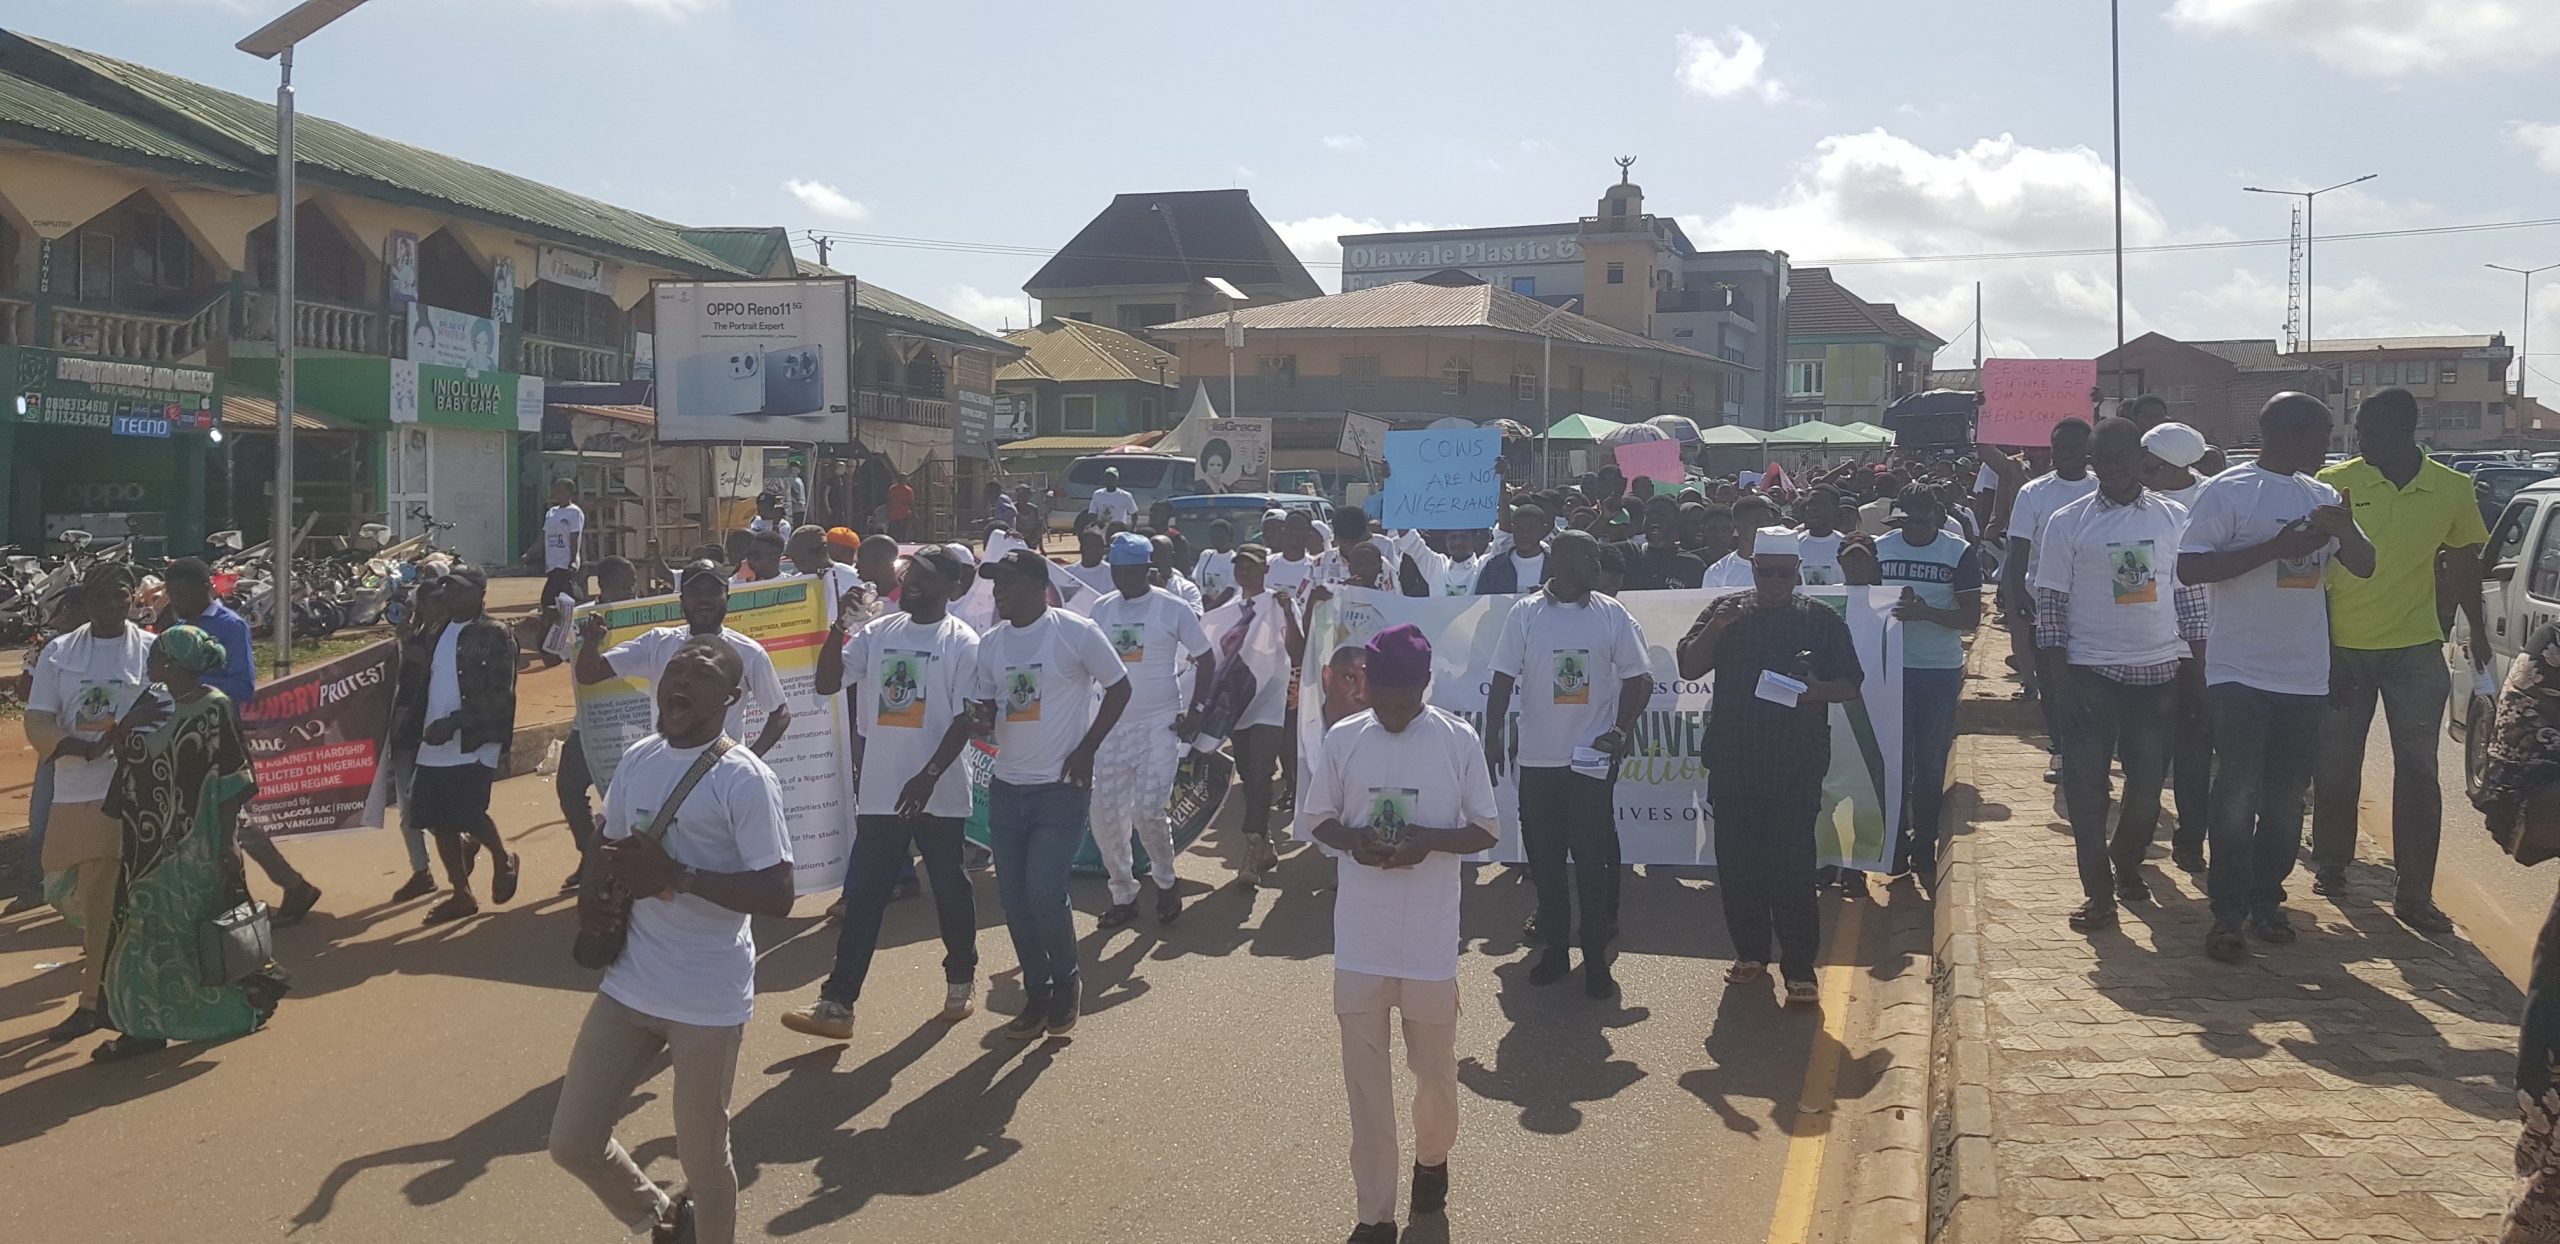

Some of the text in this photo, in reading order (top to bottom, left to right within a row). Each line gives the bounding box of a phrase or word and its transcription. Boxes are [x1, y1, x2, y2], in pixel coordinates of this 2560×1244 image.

[1350, 236, 1579, 269] Olawale Plastic &
[41, 238, 52, 293] TRAINING
[706, 302, 745, 316] OPPO
[747, 302, 791, 316] Reno11
[713, 321, 785, 332] The Portrait Expert
[2057, 362, 2091, 375] THE
[432, 378, 501, 400] INIOLUWA
[436, 396, 499, 415] BABY CARE
[119, 417, 168, 434] TECNO
[1418, 438, 1483, 463] COWS
[1425, 473, 1463, 492] ARE
[1881, 562, 1939, 580] MKO GCFR
[240, 661, 386, 720] UNGRY PROTEST
[1672, 680, 1712, 695] COA
[246, 719, 330, 752] une 12
[787, 729, 832, 741] international
[1629, 711, 1711, 757] NIVE
[316, 744, 366, 760] HARDSHIP
[810, 751, 834, 759] needy
[256, 757, 374, 783] FLICTED ON NIGERIANS
[804, 772, 837, 782] Nigerian
[258, 782, 299, 797] TINUBU
[251, 798, 298, 813] Sponsored
[276, 807, 312, 820] LAGOS
[313, 804, 332, 815] AAC
[822, 800, 839, 808] that
[1619, 807, 1673, 821] IVES
[285, 816, 336, 829] VANGUARD
[803, 832, 816, 841] the
